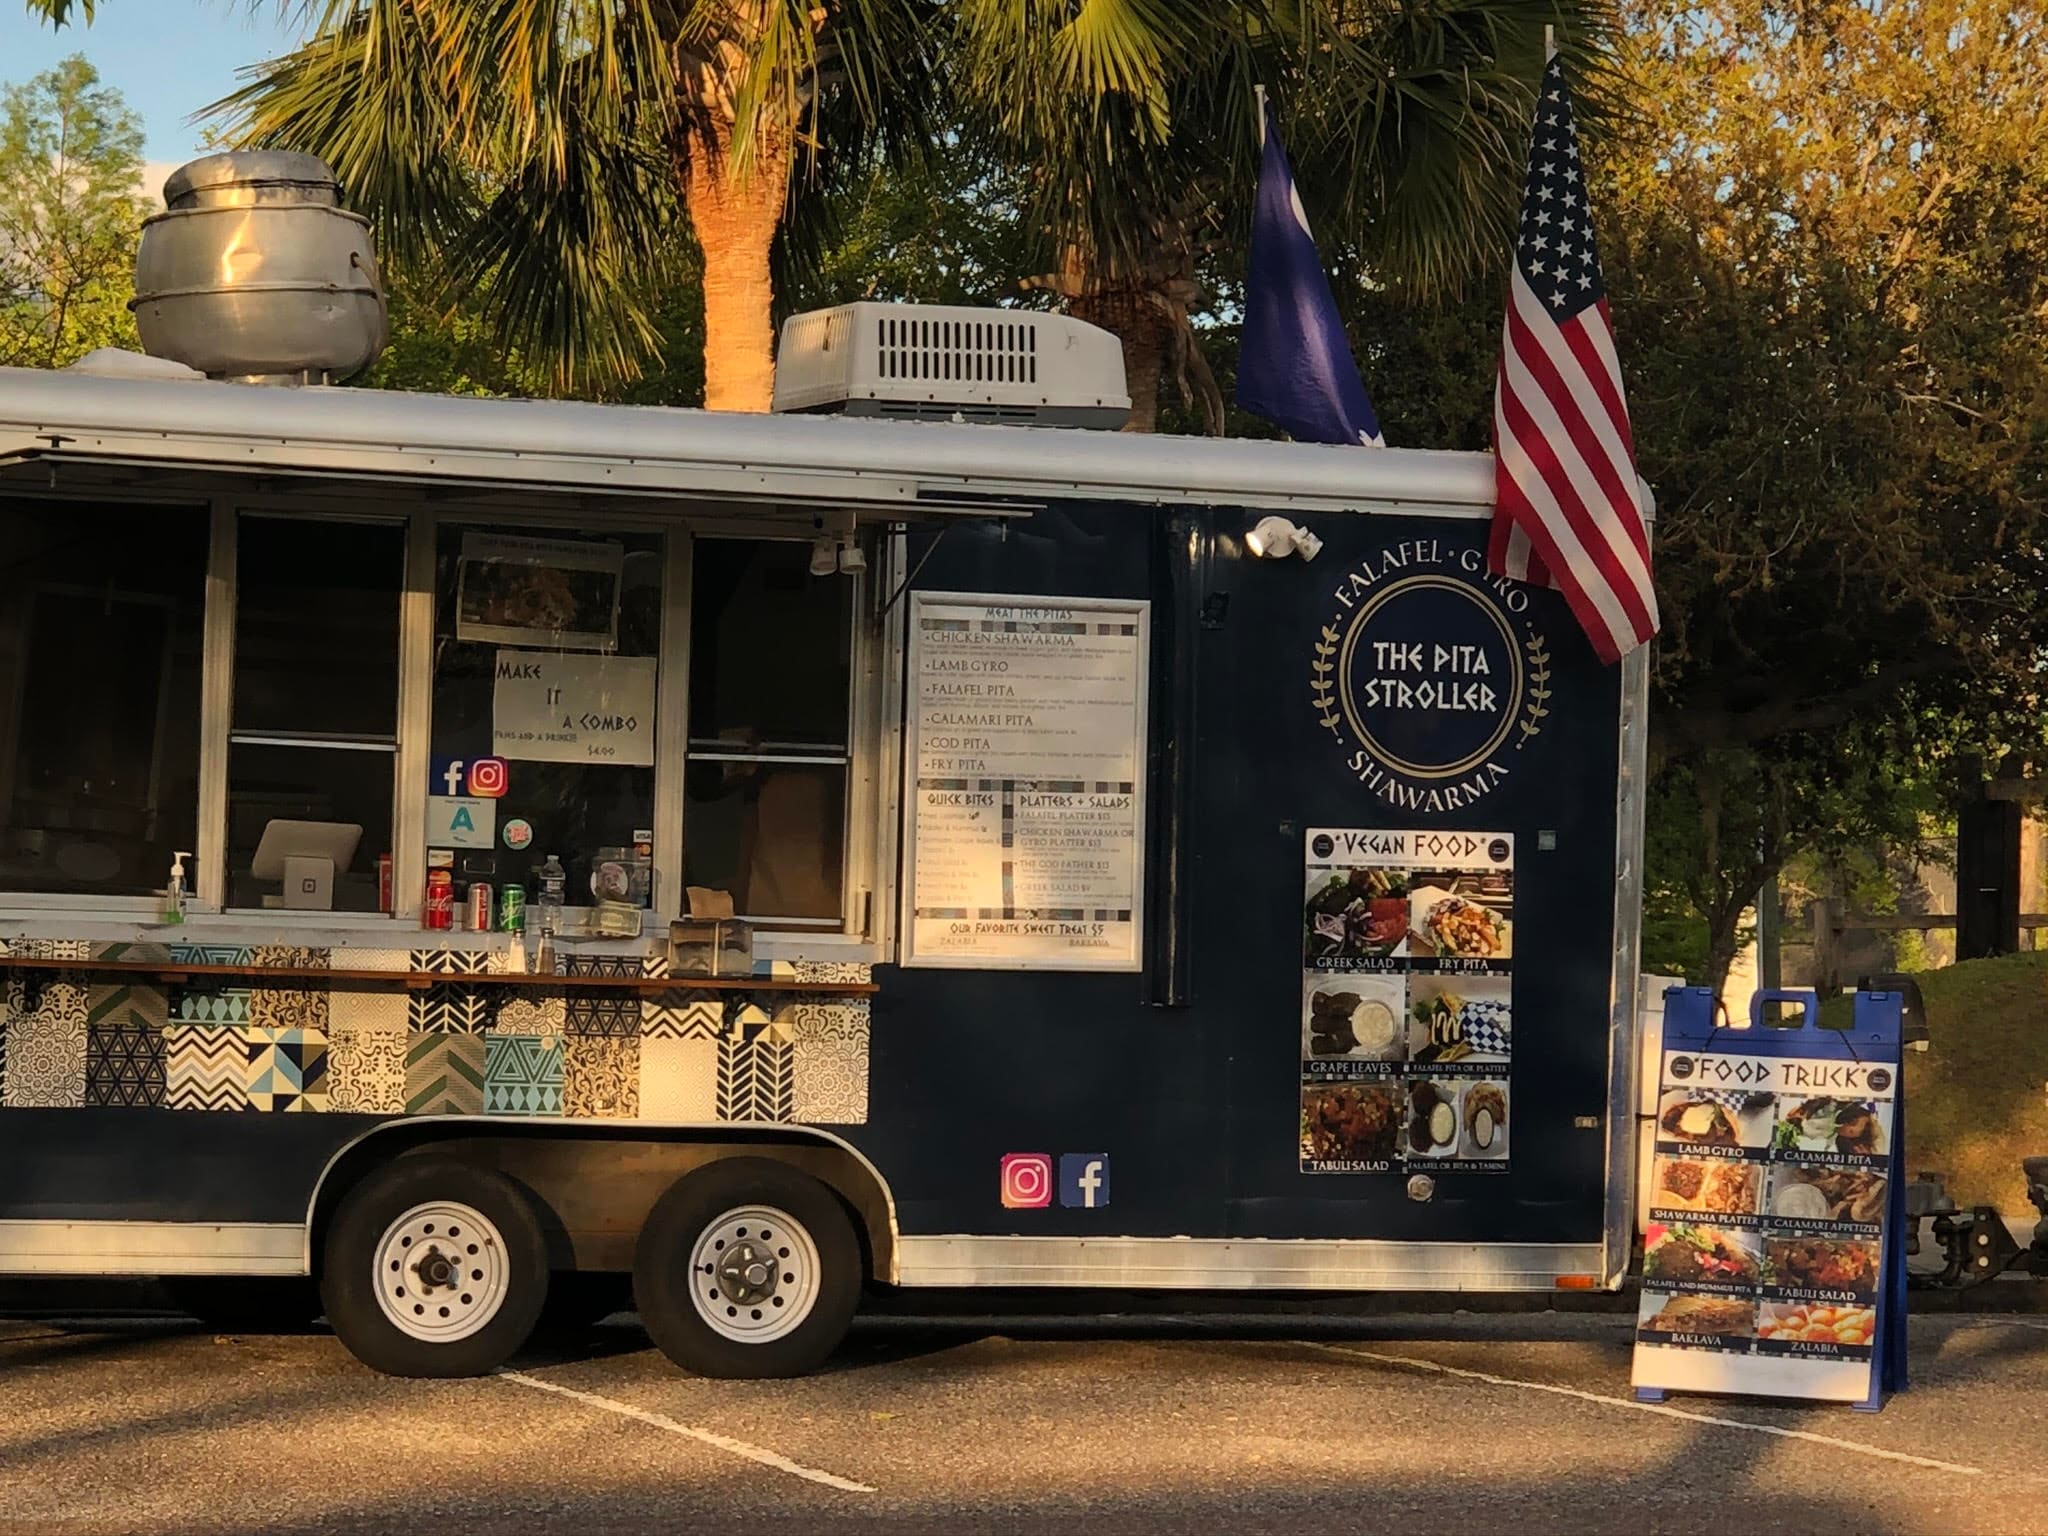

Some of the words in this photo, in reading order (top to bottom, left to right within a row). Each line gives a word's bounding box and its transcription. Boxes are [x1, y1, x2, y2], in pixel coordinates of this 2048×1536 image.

[1334, 539, 1443, 609] FALAFEL
[985, 607, 1013, 619] MEAT
[1020, 608, 1041, 619] THE
[1042, 609, 1073, 620] PITAS
[931, 631, 992, 643] CHICKEN
[994, 633, 1075, 646] SHAWARMA
[1372, 642, 1423, 672] THE
[1434, 644, 1490, 674] PITA
[497, 661, 541, 680] MAKE
[932, 660, 970, 671] LAMB
[971, 660, 1009, 672] GYRO
[547, 688, 562, 705] IT
[931, 684, 983, 696] FALAFEL
[987, 684, 1015, 696] PITA
[1364, 678, 1497, 712] STROLLER
[563, 715, 572, 729] A
[580, 712, 637, 732] COMBO
[931, 713, 1001, 726] CALAMARI
[1006, 714, 1033, 726] PITA
[930, 738, 959, 749] COD
[963, 738, 990, 749] PITA
[931, 759, 954, 770] FRY
[958, 760, 986, 770] PITA
[1347, 750, 1509, 812] SHAWARMA
[928, 794, 961, 806] QUICK
[965, 794, 994, 806] BITES
[1020, 795, 1073, 807] PLATTERS
[1089, 796, 1130, 808] SALADS
[449, 806, 475, 832] A
[1344, 833, 1405, 855] VEGAN
[1415, 834, 1477, 857] FOOD
[975, 922, 1019, 934] FAVORITE
[1024, 923, 1054, 935] SWEET
[1060, 923, 1087, 935] TREAT
[1316, 957, 1355, 968] GREEK
[1356, 957, 1395, 969] SALAD
[1439, 958, 1461, 969] FRY
[1463, 959, 1489, 969] PITA
[1310, 1062, 1350, 1073] GRAPE
[1352, 1063, 1392, 1073] LEAVES
[1700, 1058, 1770, 1084] FOOD
[1781, 1064, 1860, 1088] TRUCK
[1678, 1143, 1711, 1155] LAMB
[1712, 1146, 1744, 1158] GYRO
[1784, 1151, 1845, 1163] CALAMARI
[1847, 1154, 1872, 1165] PITA
[1312, 1161, 1351, 1171] TABULI
[1352, 1161, 1389, 1171] SALAD
[1654, 1209, 1715, 1223] SHAWARMA
[1718, 1213, 1759, 1226] PLATTER
[1774, 1218, 1829, 1231] CALAMARI
[1830, 1220, 1880, 1233] APPETIZER
[1778, 1287, 1816, 1299] TABULI
[1818, 1289, 1856, 1301] SALAD
[1671, 1333, 1721, 1345] BAKLAVA
[1791, 1341, 1839, 1354] ZALABIA
